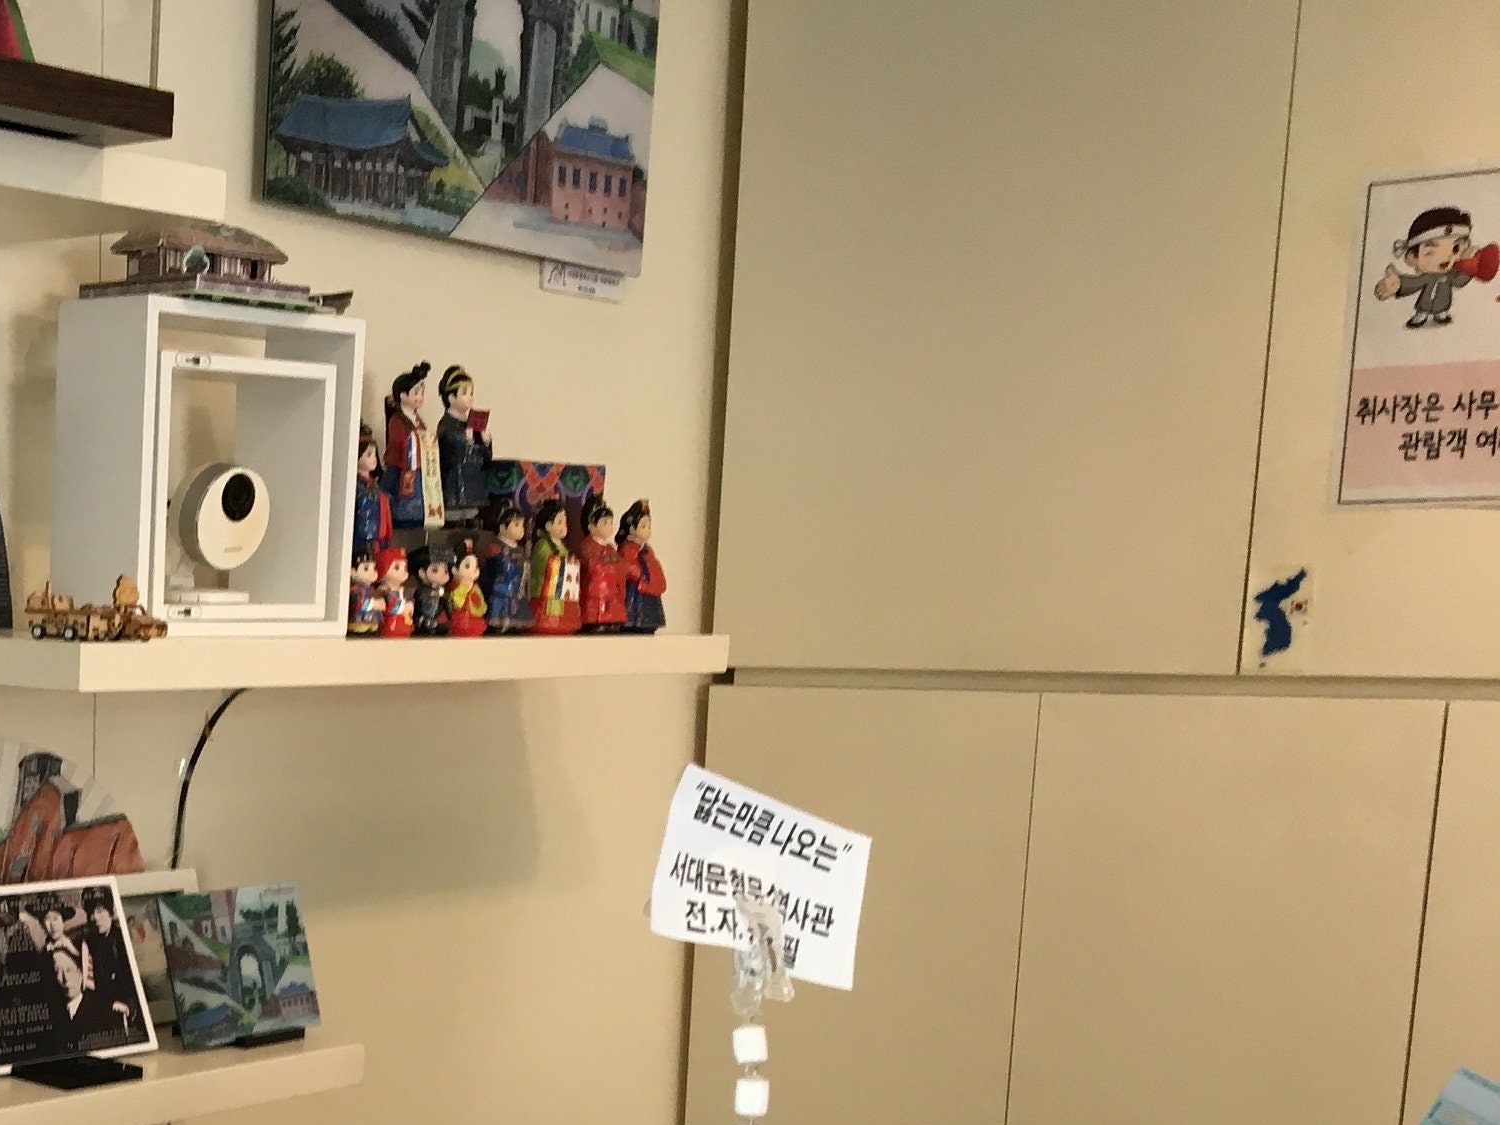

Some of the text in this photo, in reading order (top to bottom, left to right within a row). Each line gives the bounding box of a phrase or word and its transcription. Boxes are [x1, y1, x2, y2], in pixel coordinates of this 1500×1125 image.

[1355, 391, 1444, 425] 취사장은
[1398, 425, 1500, 461] 관람객 여
